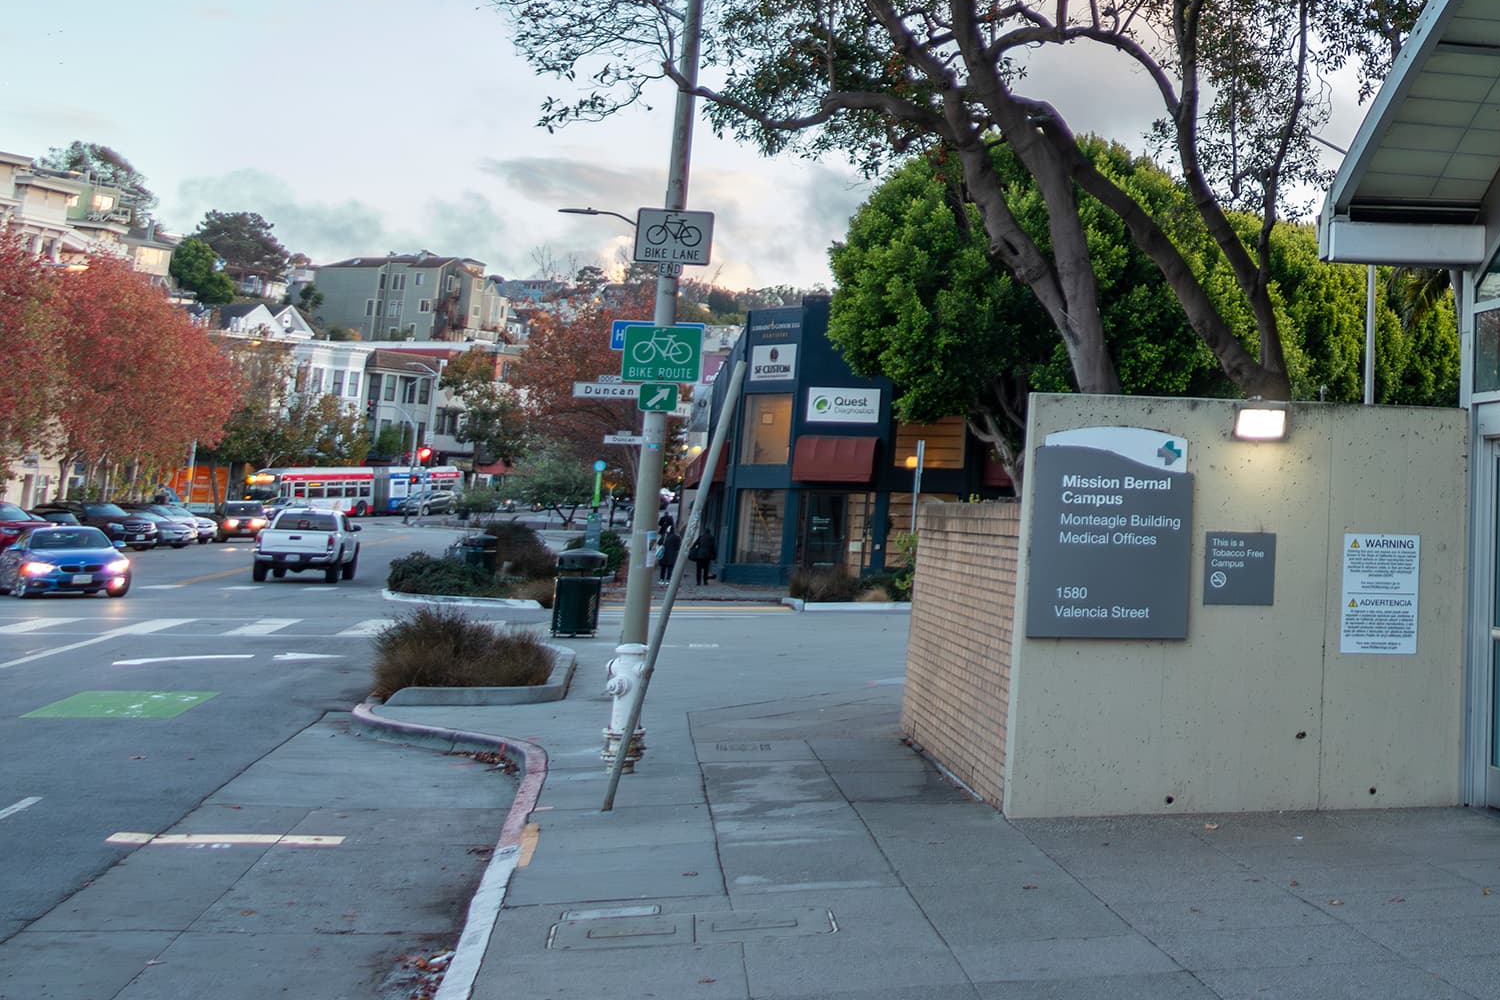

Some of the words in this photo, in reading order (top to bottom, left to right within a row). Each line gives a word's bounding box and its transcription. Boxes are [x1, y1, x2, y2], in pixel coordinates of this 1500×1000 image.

[644, 247, 668, 259] BIKE
[672, 249, 700, 260] LANE
[660, 263, 681, 274] END
[628, 366, 652, 378] BIKE
[658, 367, 693, 379] ROUTE
[584, 385, 635, 396] Duncan
[834, 396, 868, 407] Quest
[1062, 475, 1120, 488] Mission
[1124, 476, 1171, 490] Bernal
[1061, 491, 1123, 507] Campus
[1060, 513, 1127, 528] Monteagle
[1131, 514, 1181, 530] Building
[1059, 531, 1109, 544] Medical
[1112, 532, 1157, 545] Offices
[1212, 538, 1229, 547] This
[1230, 539, 1237, 547] is
[1365, 539, 1415, 549] WARNING
[1211, 548, 1245, 557] Tobacco
[1246, 549, 1265, 558] Free
[1211, 558, 1245, 568] Campus
[1056, 586, 1088, 599] 1580
[1360, 599, 1412, 607] ADVERTENCIA
[1054, 605, 1108, 618] Valencia
[1111, 605, 1150, 618] Street
